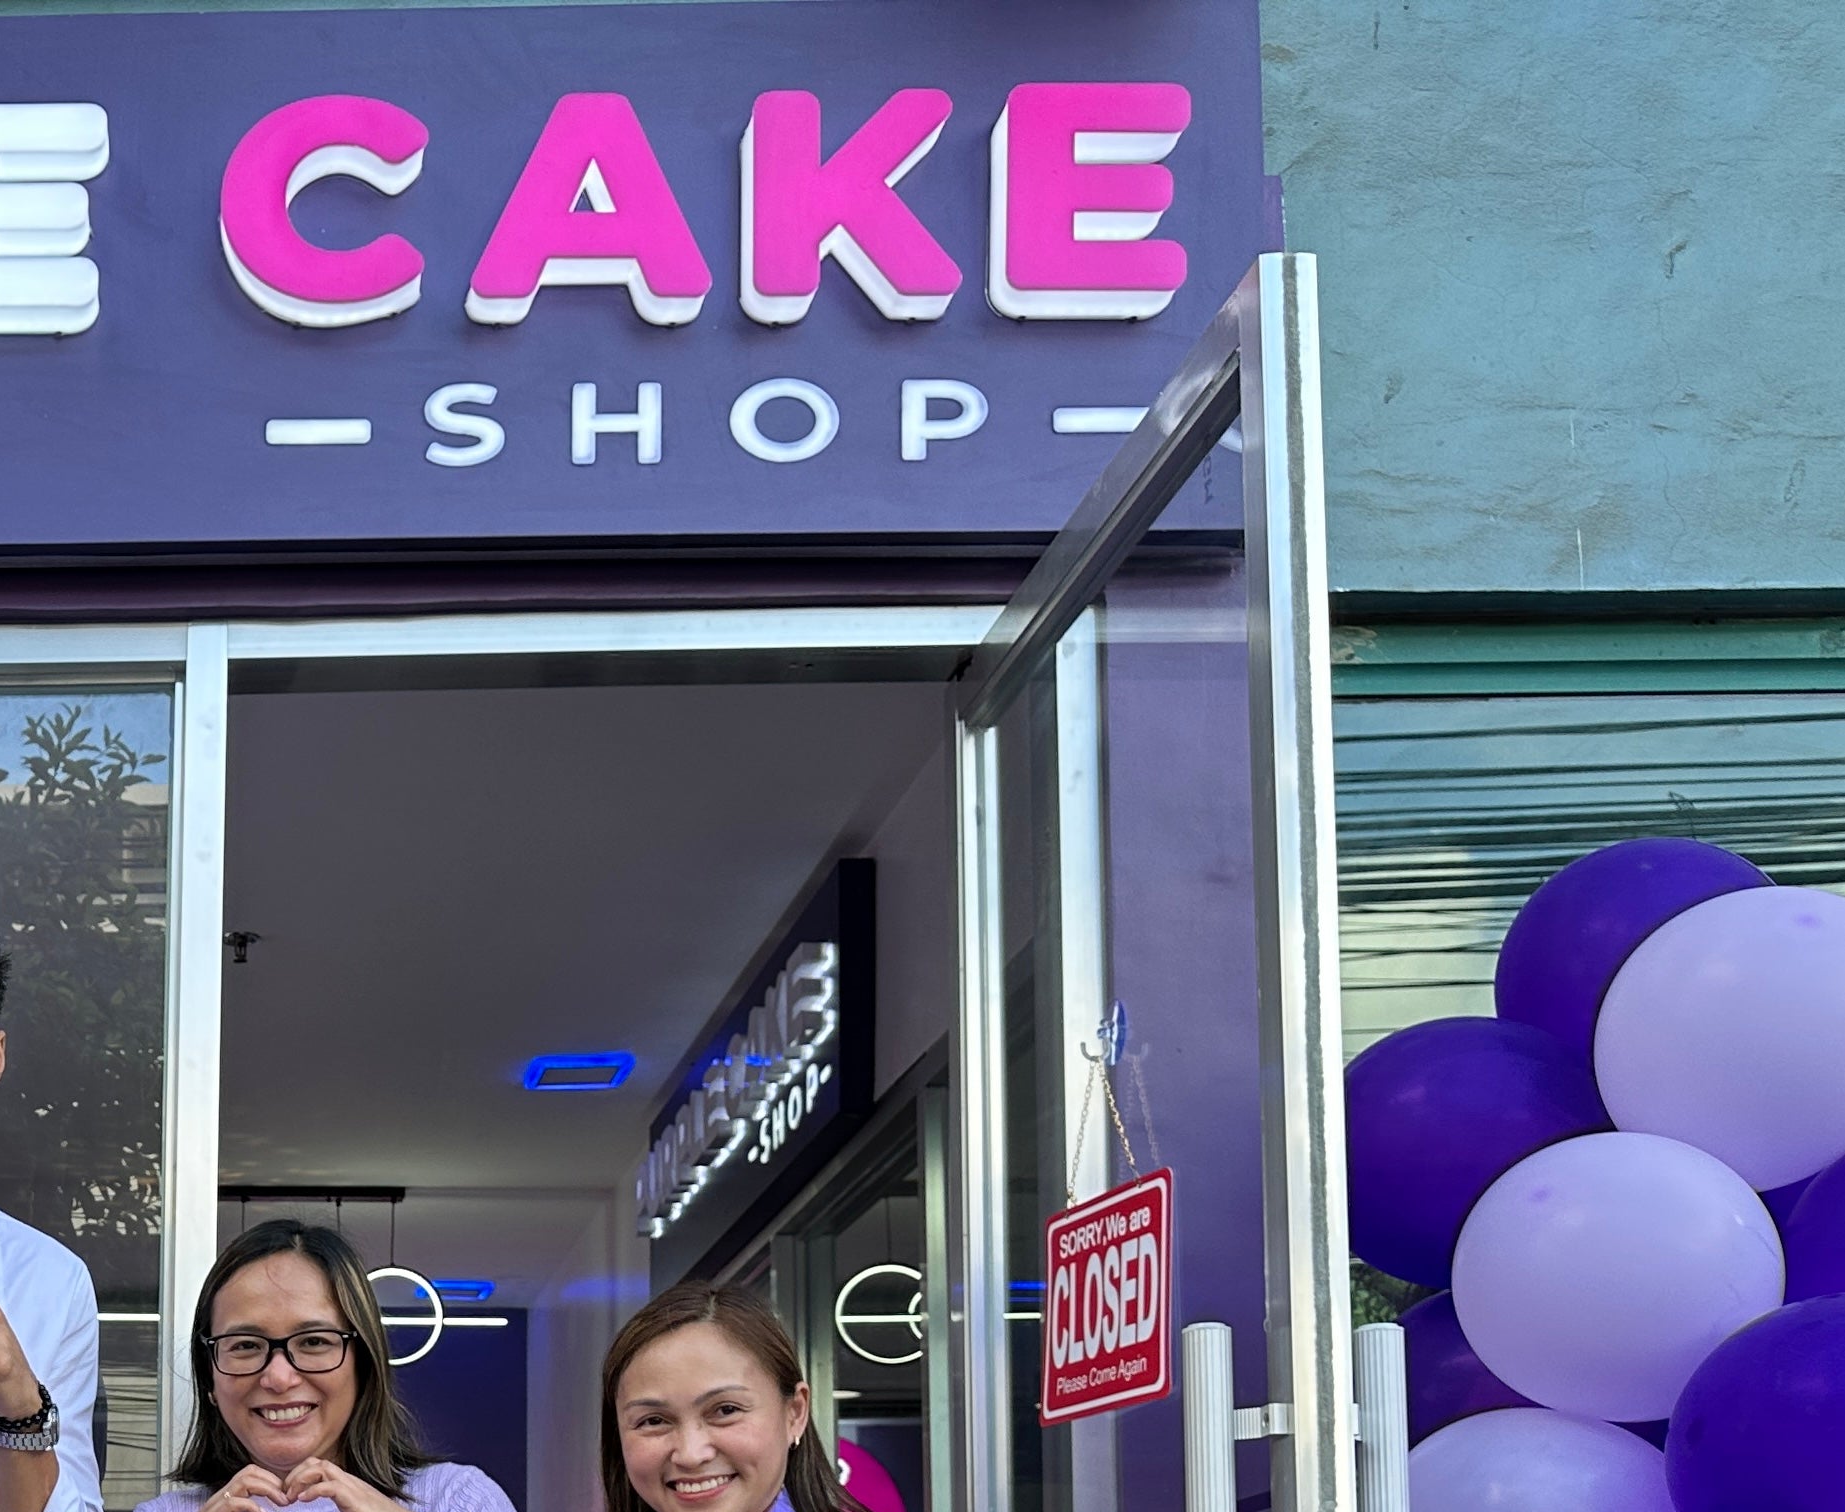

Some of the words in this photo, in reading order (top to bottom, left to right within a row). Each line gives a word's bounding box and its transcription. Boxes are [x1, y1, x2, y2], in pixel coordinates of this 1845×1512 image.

[219, 82, 1192, 327] CAKE
[422, 378, 989, 467] SHOP
[759, 1063, 820, 1164] SHOP
[1129, 1206, 1151, 1232] are
[1052, 1232, 1159, 1369] CLOSED
[1056, 1374, 1088, 1397] Please
[1089, 1366, 1116, 1387] Come
[1117, 1354, 1147, 1382] Again
